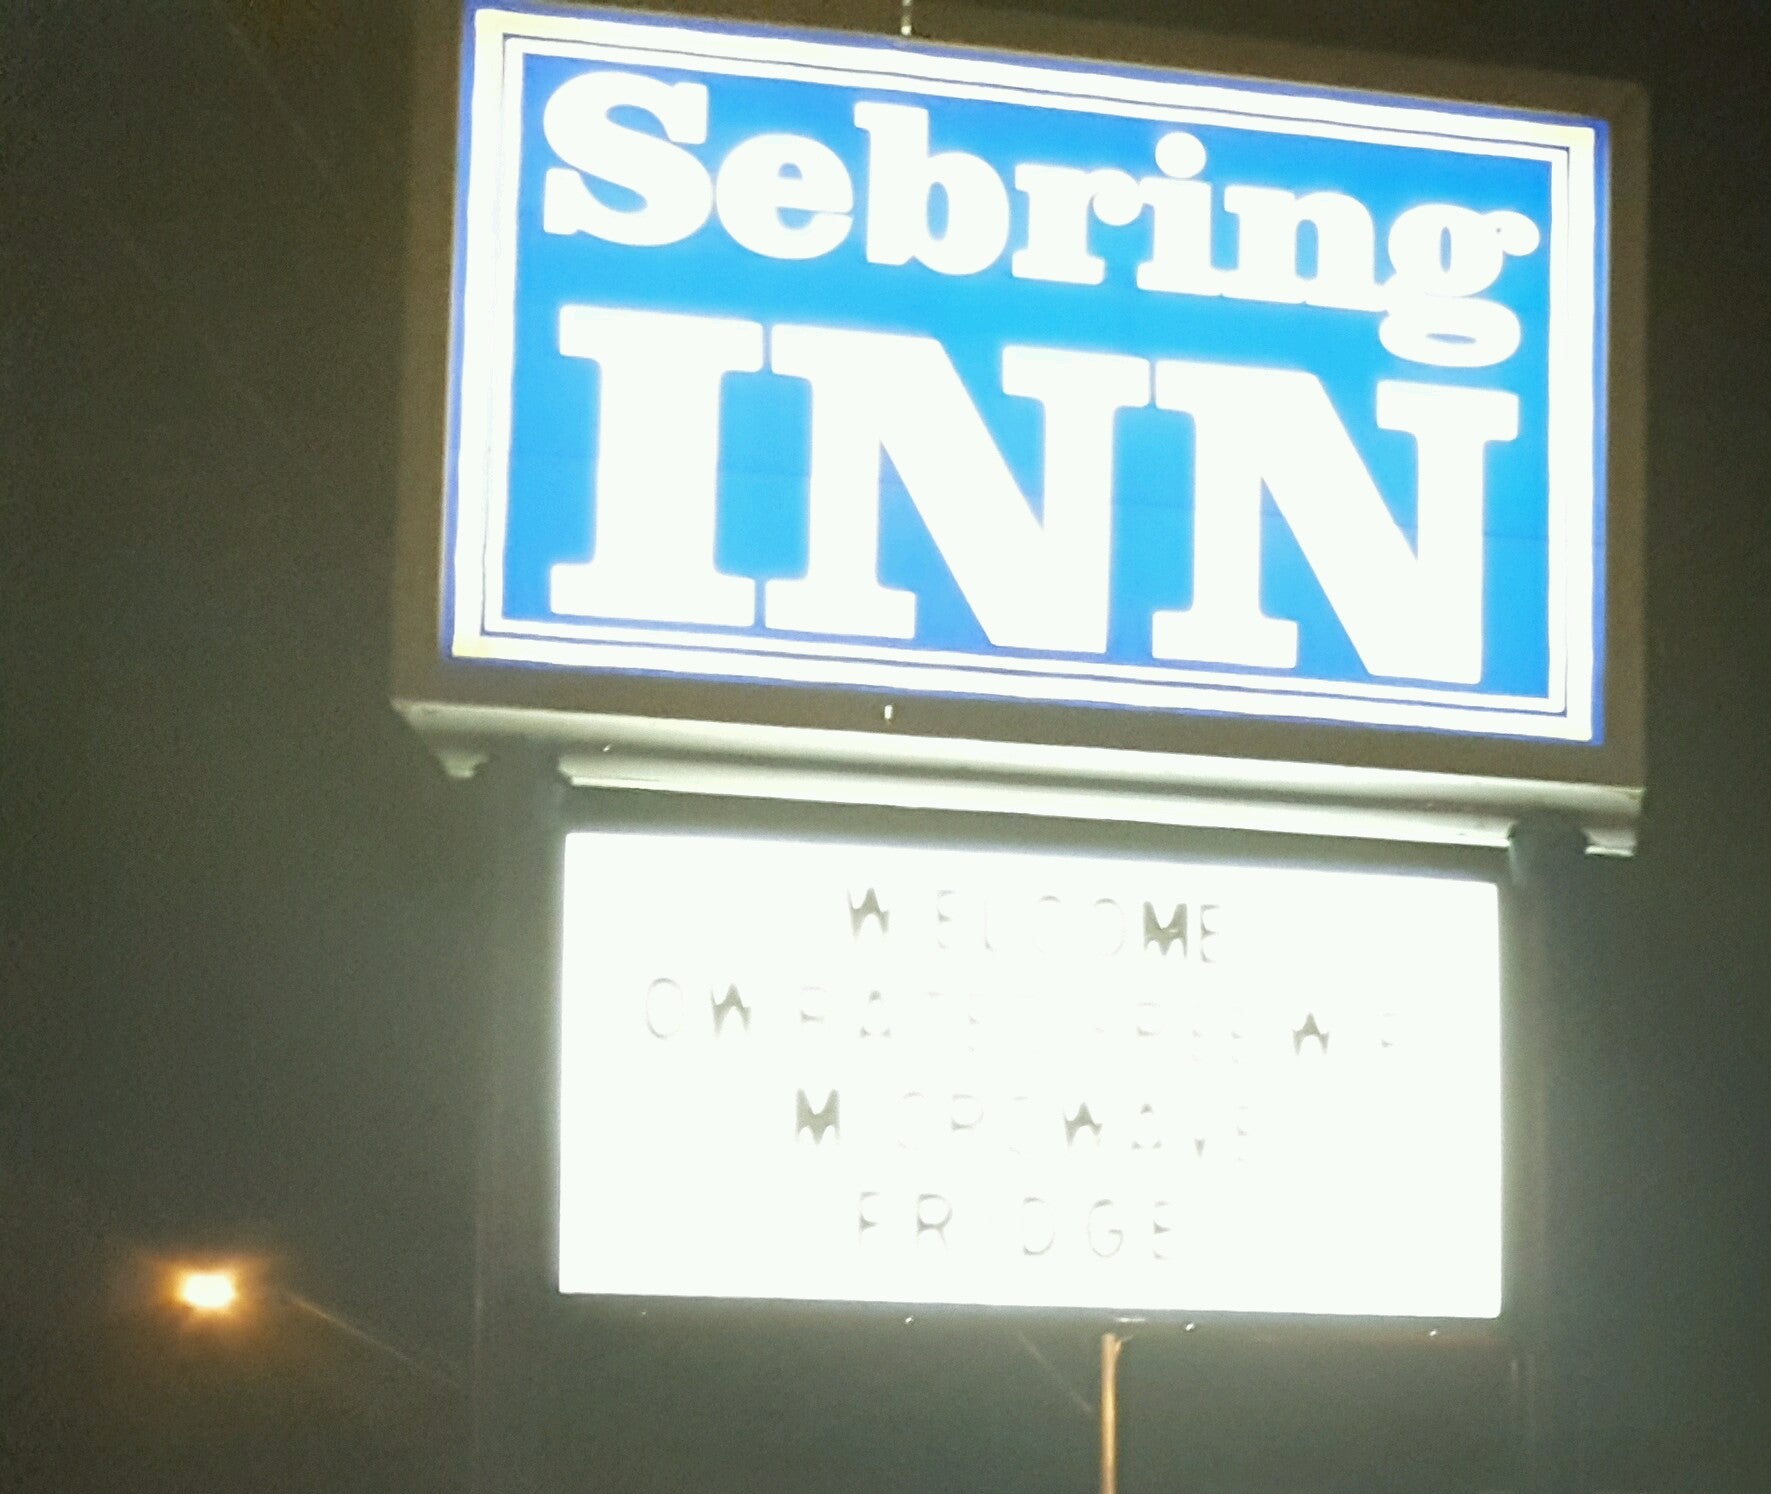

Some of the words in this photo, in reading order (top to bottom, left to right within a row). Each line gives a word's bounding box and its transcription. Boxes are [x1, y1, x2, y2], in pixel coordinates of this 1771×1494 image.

[542, 69, 1541, 367] Sebring
[548, 303, 1520, 684] INN
[856, 1190, 1173, 1260] FRDGE
